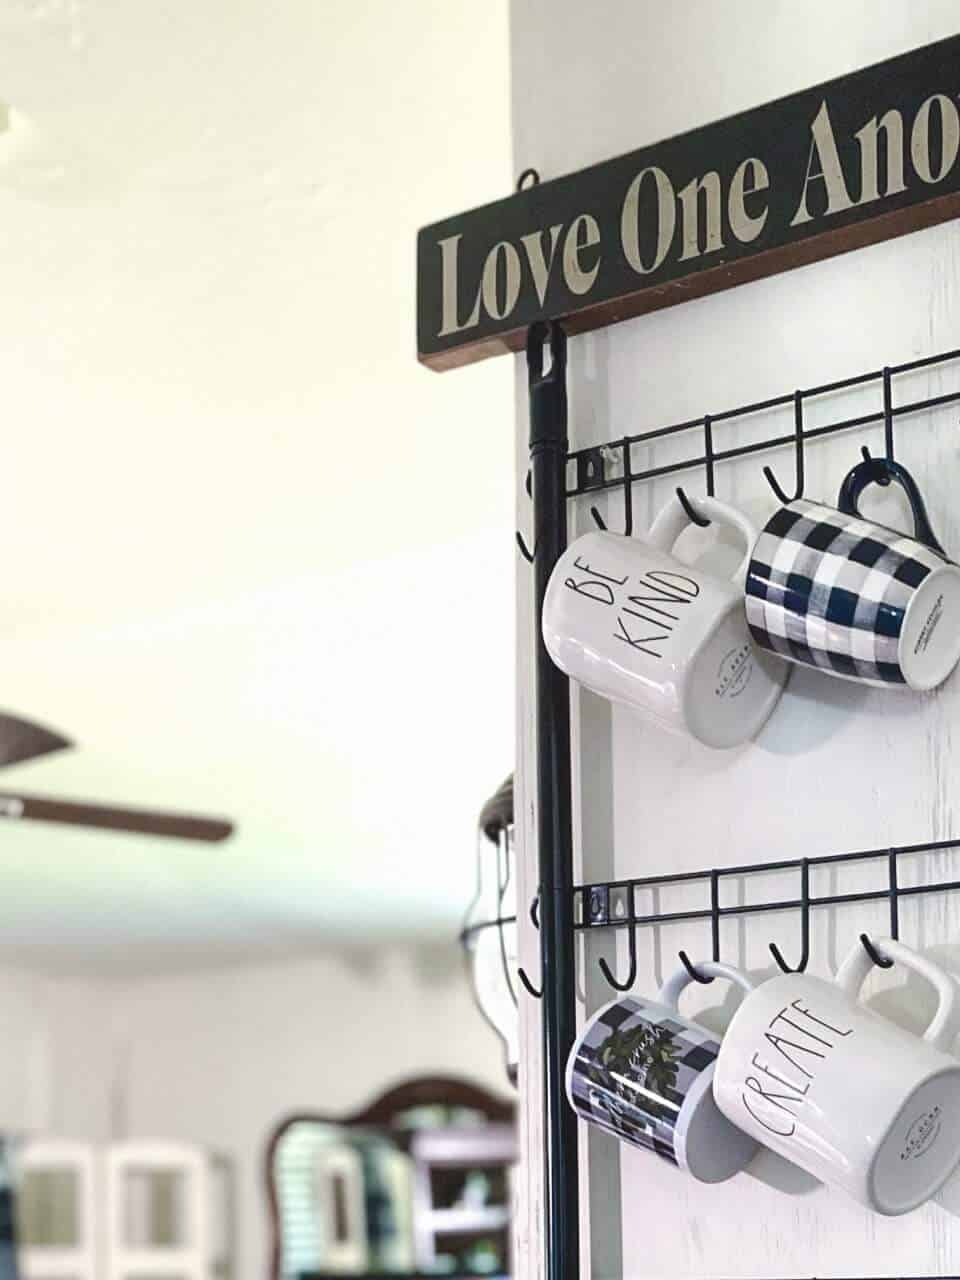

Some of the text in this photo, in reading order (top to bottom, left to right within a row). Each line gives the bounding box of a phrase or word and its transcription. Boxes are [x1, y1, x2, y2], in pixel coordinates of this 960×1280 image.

[437, 212, 600, 337] Love
[620, 156, 769, 275] One
[564, 556, 629, 605] BE
[613, 570, 701, 659] KIND
[742, 1000, 853, 1137] CREATE
